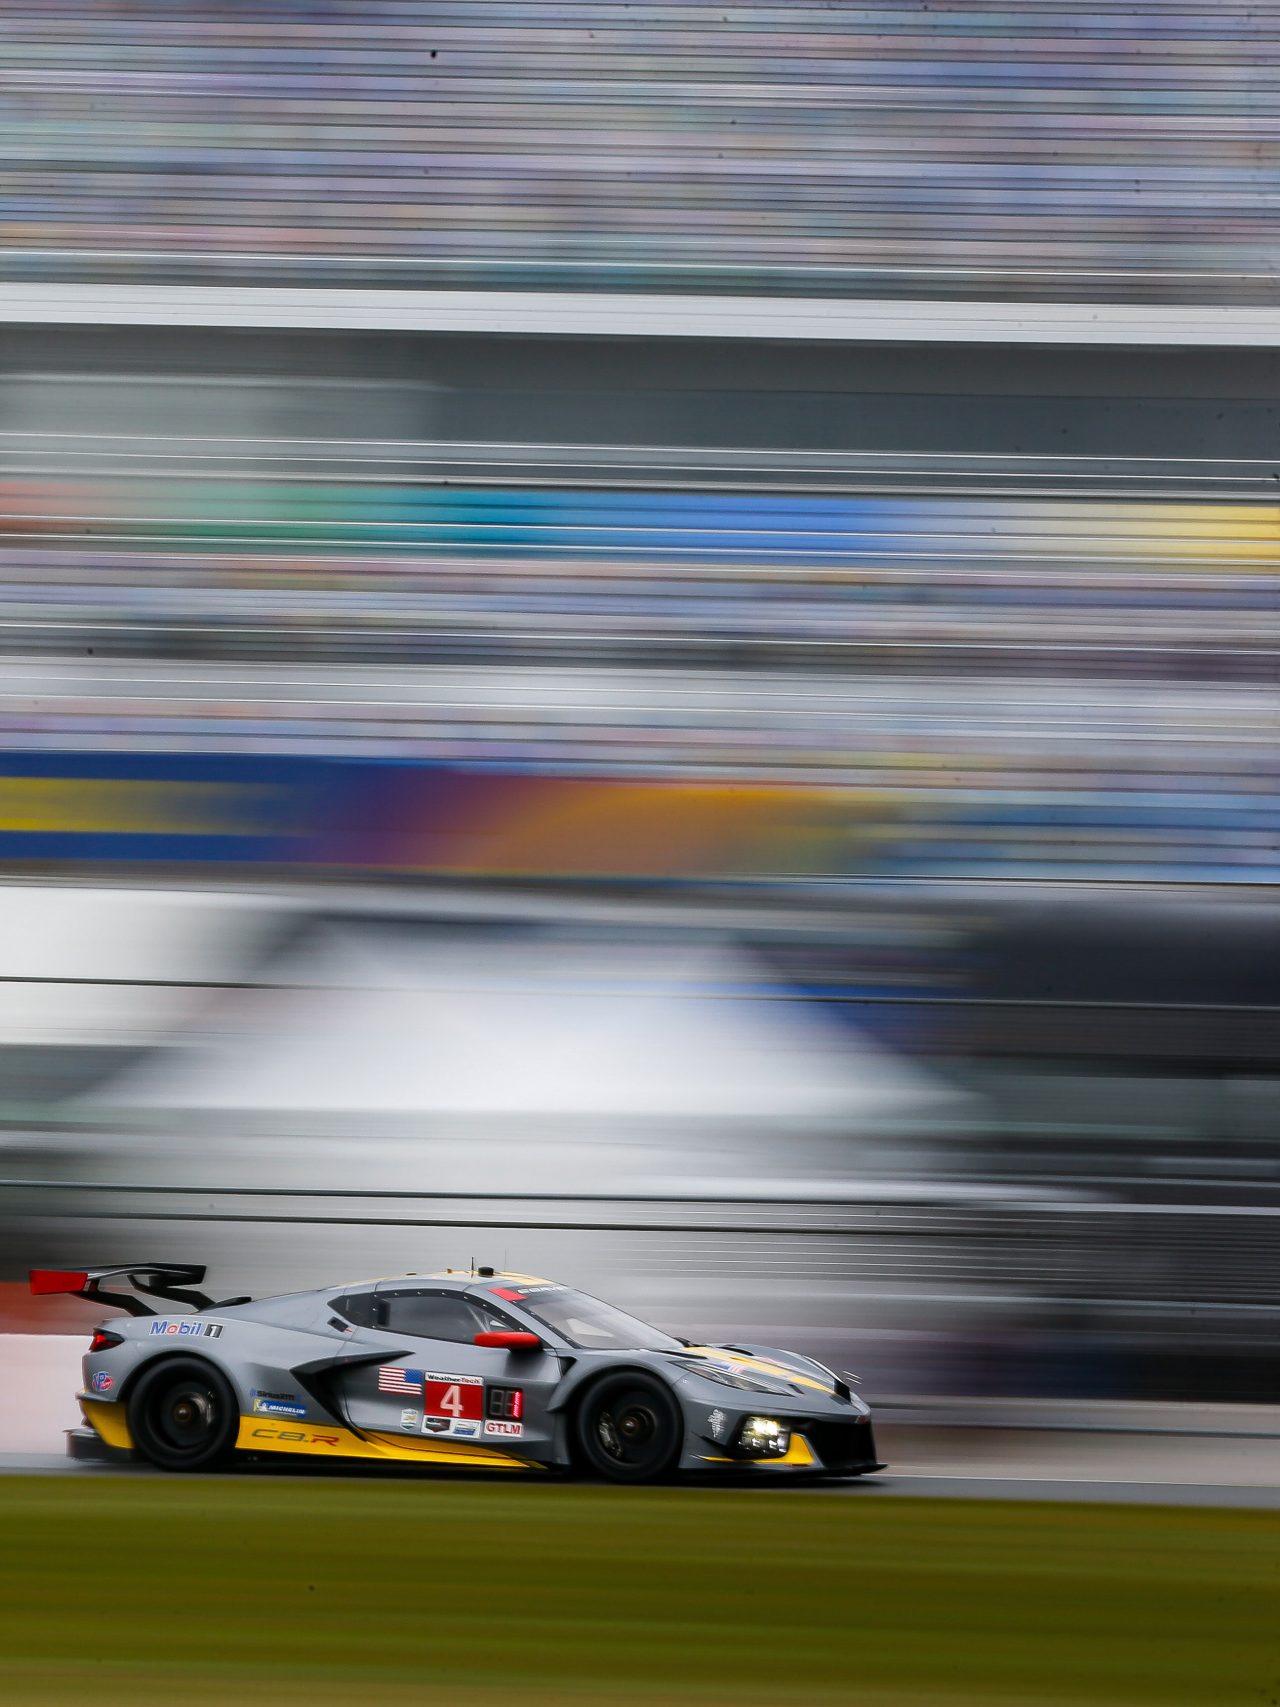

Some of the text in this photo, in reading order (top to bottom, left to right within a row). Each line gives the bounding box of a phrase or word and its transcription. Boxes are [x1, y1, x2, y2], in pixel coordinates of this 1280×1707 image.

[150, 1321, 202, 1335] Mobil
[428, 1374, 481, 1384] WeatherTech
[440, 1385, 464, 1417] 4
[268, 1404, 305, 1414] MICHELIN
[487, 1423, 521, 1434] GTLM
[251, 1428, 340, 1447] C8.R
